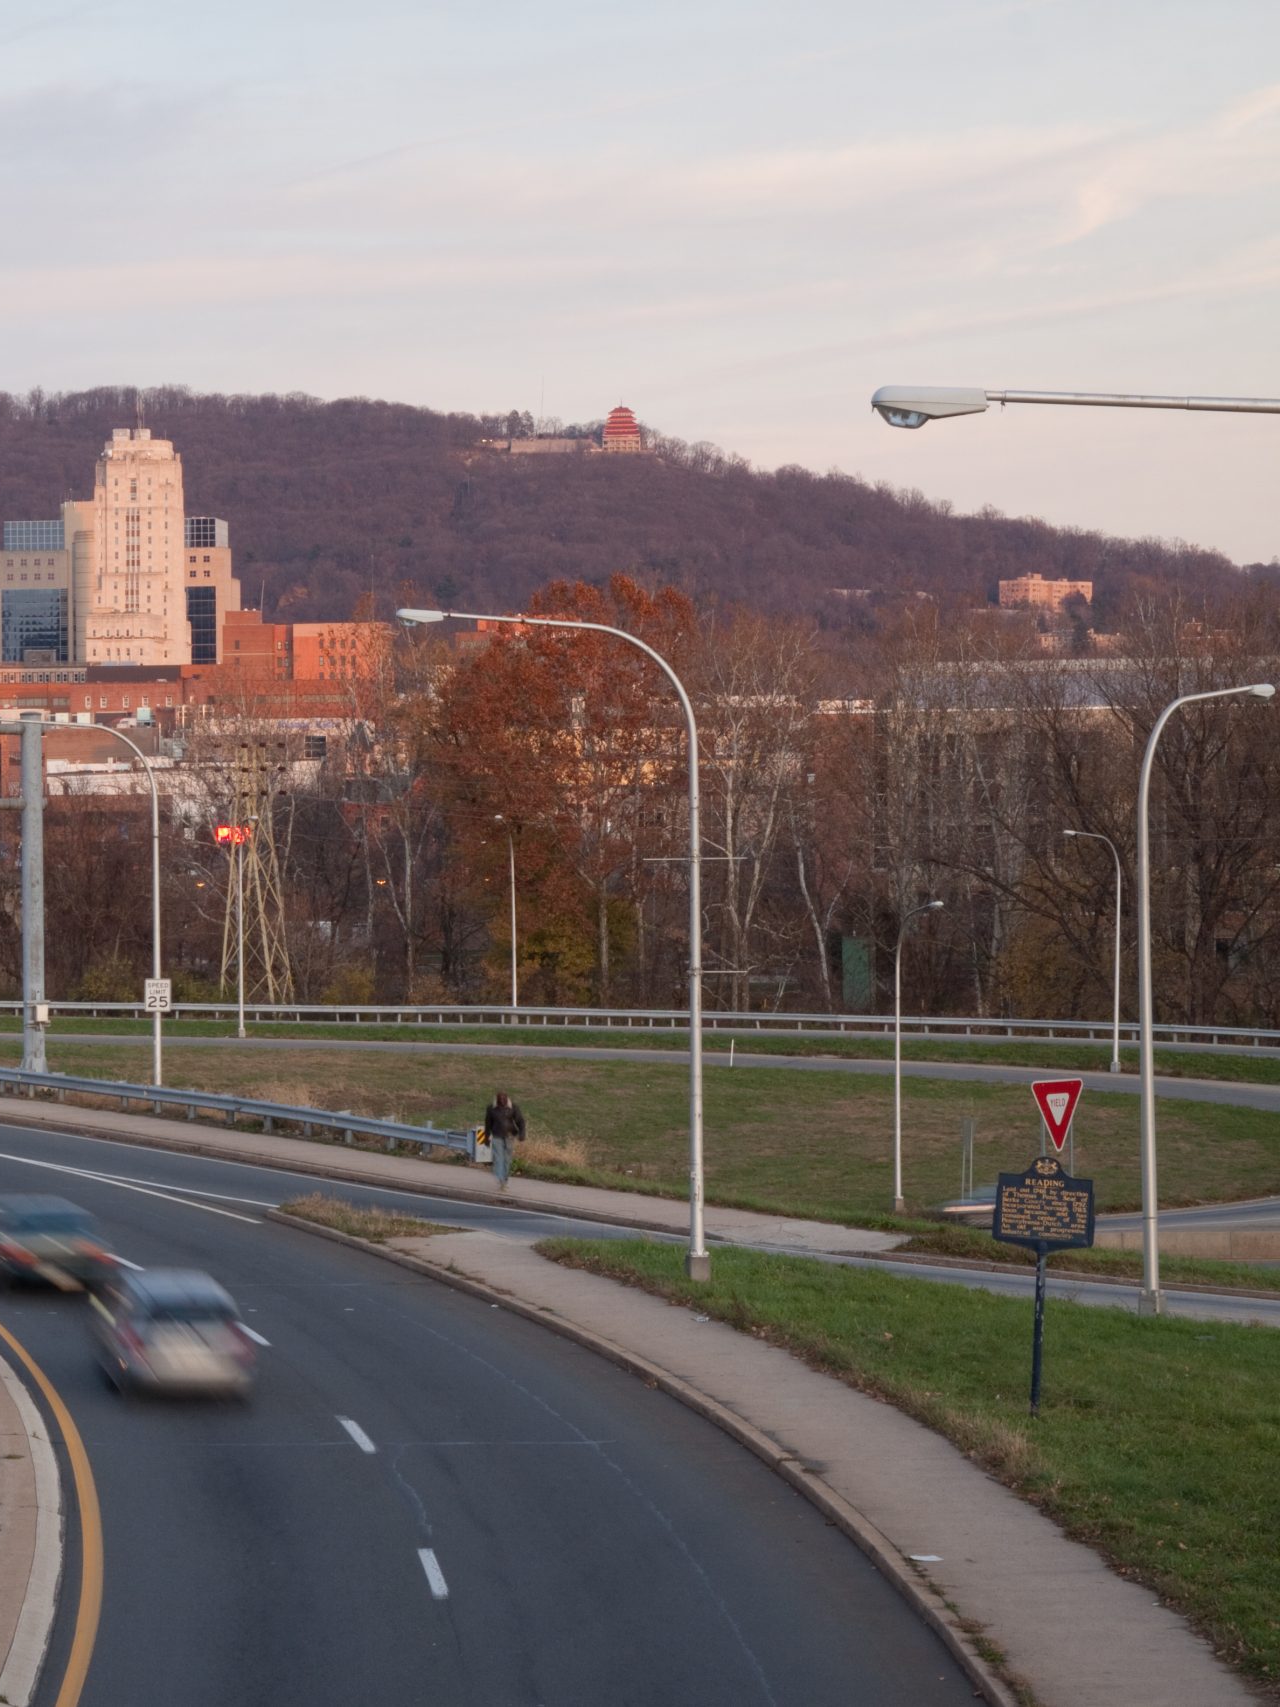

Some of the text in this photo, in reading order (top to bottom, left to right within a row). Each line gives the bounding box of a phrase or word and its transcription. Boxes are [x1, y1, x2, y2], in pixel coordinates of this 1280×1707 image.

[147, 995, 168, 1008] 25
[1050, 1097, 1066, 1107] YIELD
[1026, 1178, 1064, 1187] READING
